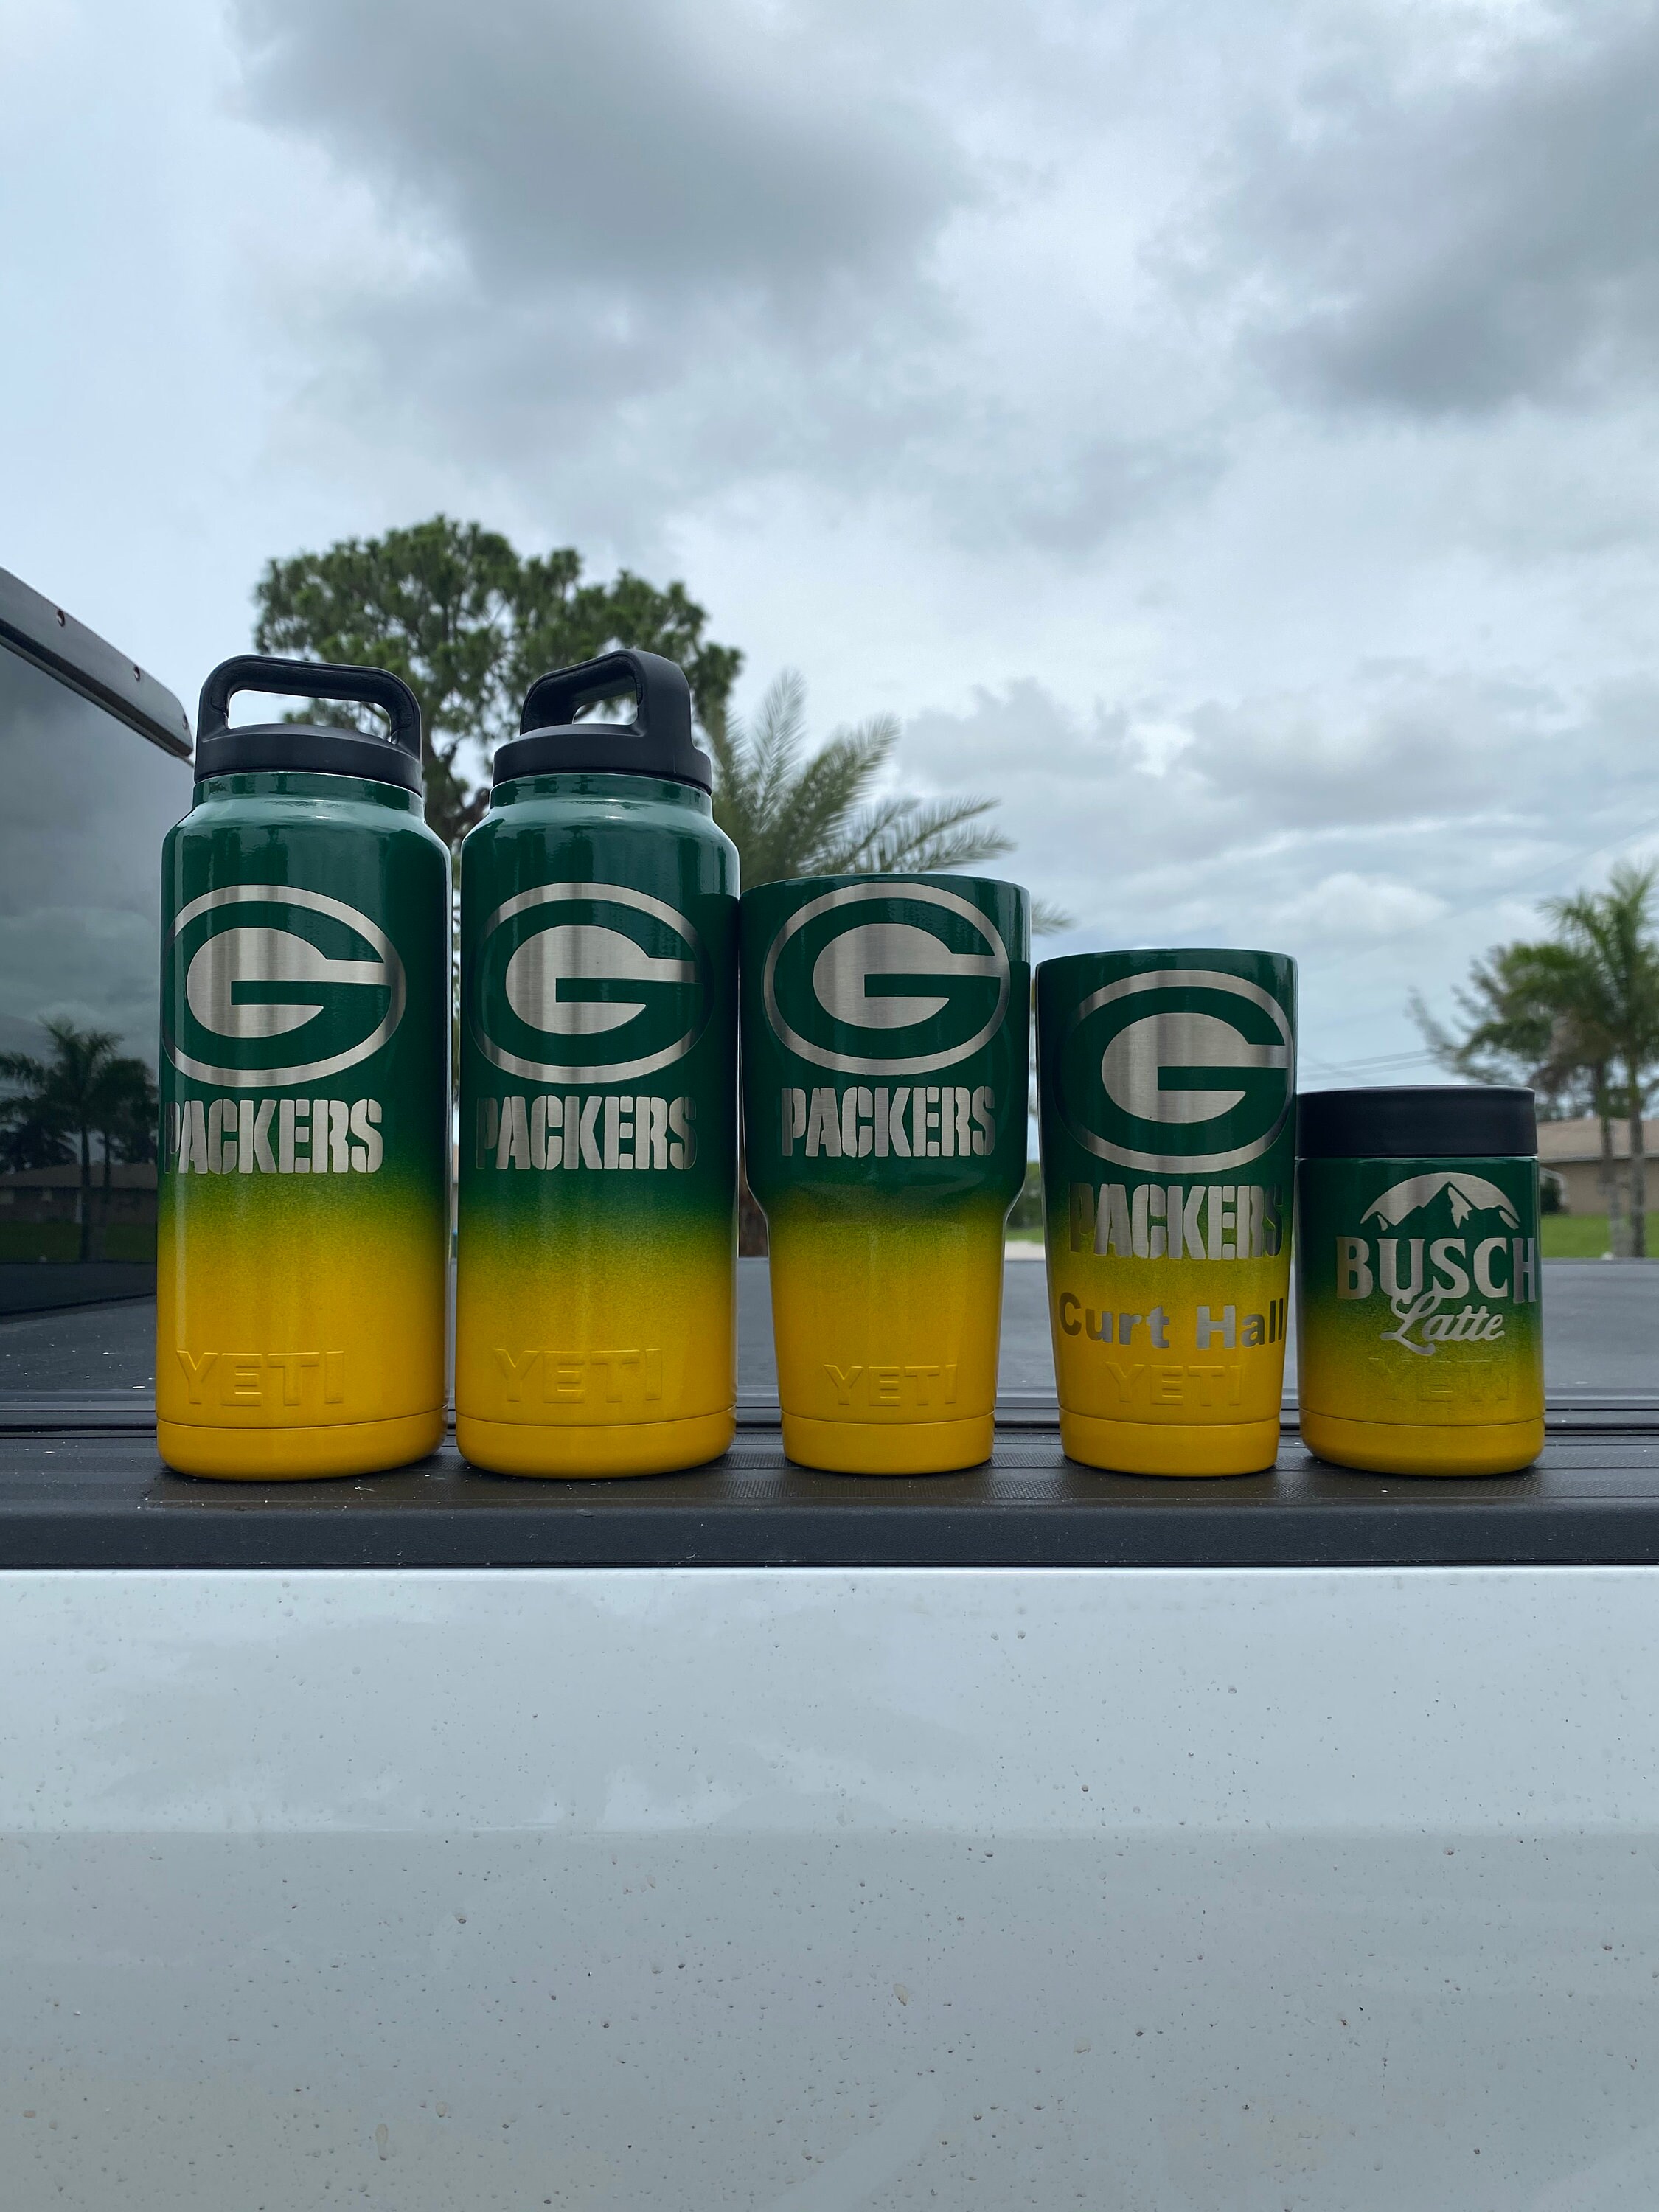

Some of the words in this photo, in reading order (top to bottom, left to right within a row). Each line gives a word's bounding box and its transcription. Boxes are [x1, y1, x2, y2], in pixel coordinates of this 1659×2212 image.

[164, 1098, 384, 1175] PACKERS
[476, 1094, 697, 1171] PACKERS
[781, 1085, 995, 1158] PACKERS
[1069, 1183, 1283, 1260] PACKERS
[1336, 1236, 1537, 1304] BUSCH
[1058, 1292, 1170, 1349] Curt
[1195, 1298, 1284, 1351] Hall
[1380, 1290, 1506, 1357] Latte
[176, 1350, 345, 1406] YETI
[493, 1348, 662, 1404] YETI
[823, 1363, 958, 1407] YETI
[1107, 1361, 1244, 1407] YETI
